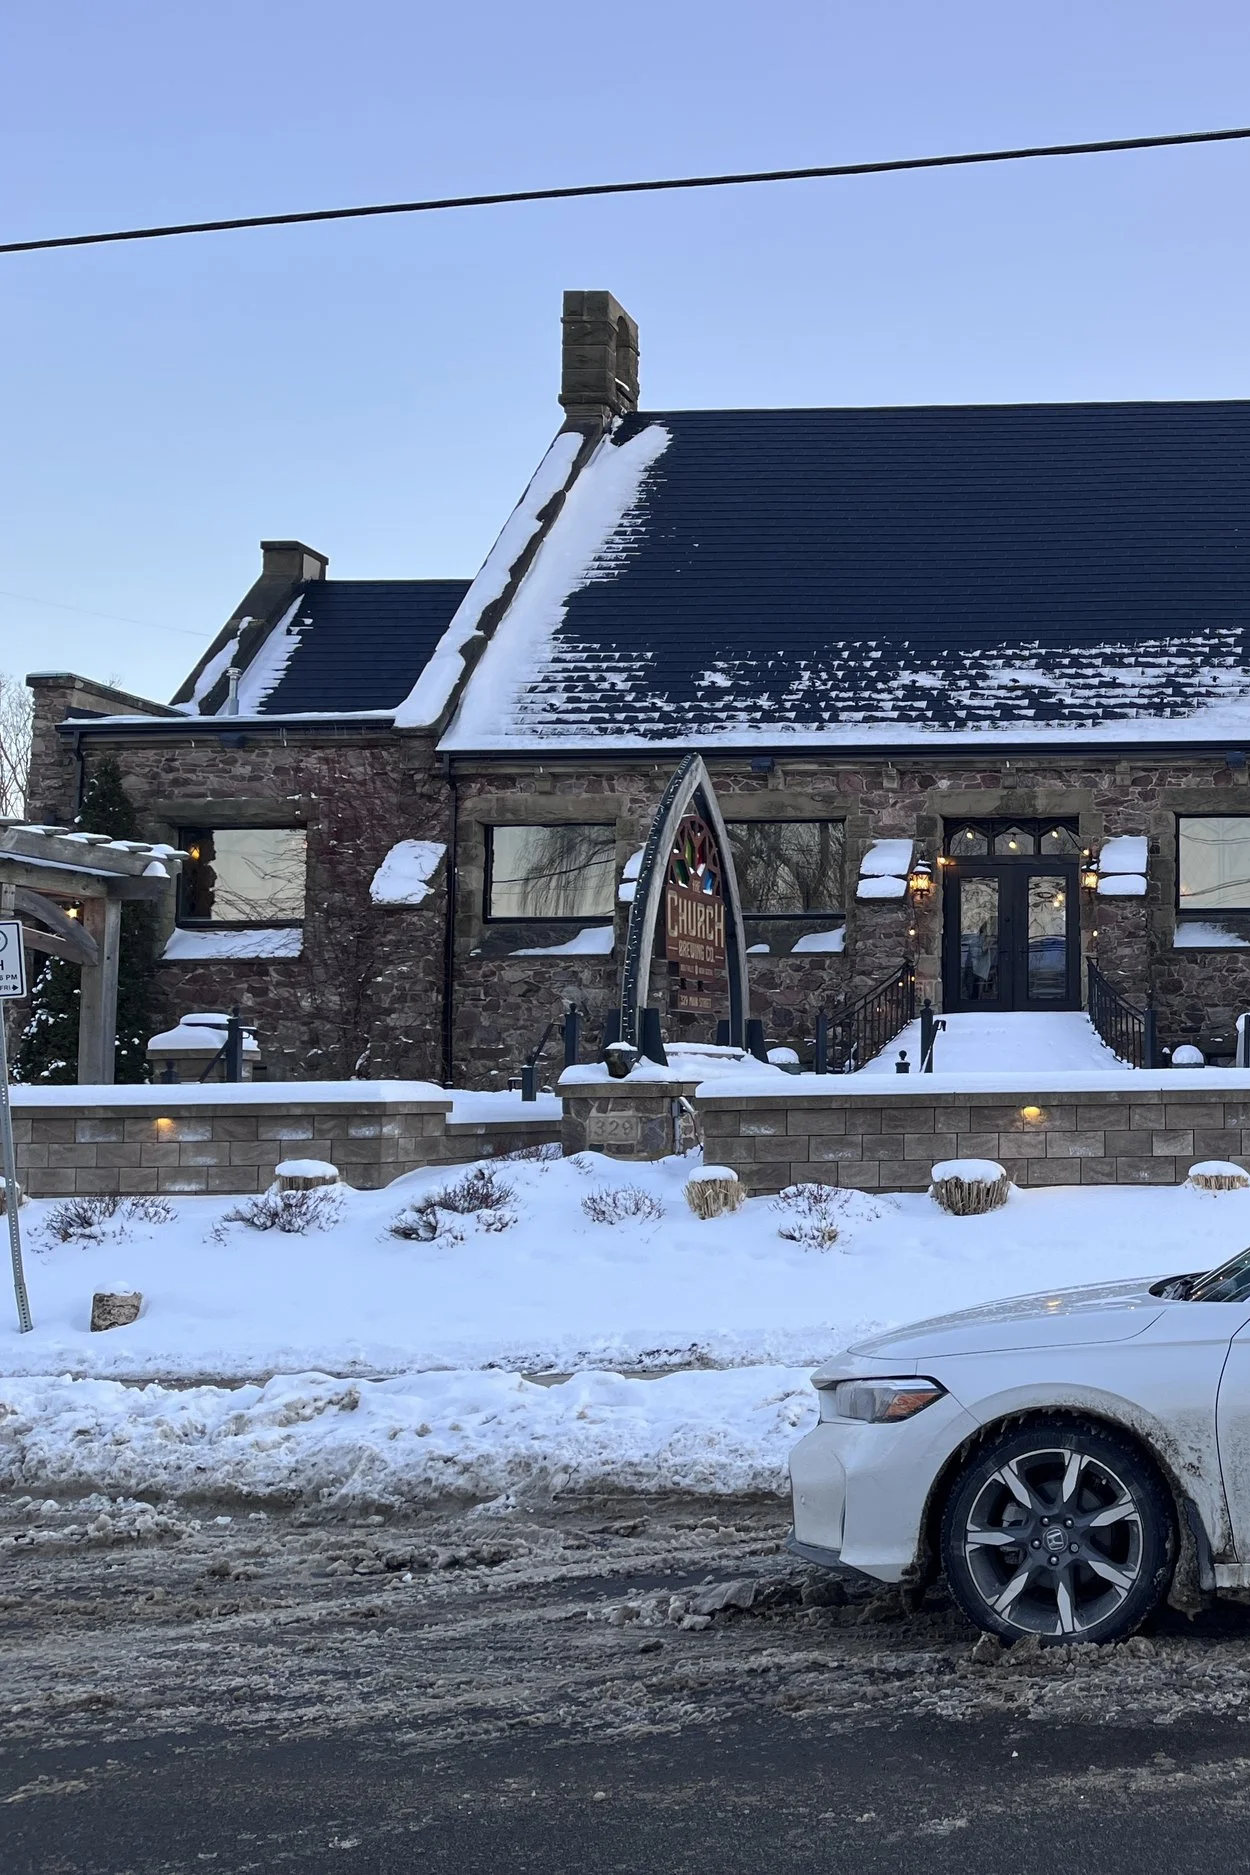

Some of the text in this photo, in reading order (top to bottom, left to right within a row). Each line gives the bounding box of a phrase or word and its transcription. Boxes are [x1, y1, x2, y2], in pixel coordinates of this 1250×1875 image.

[668, 890, 724, 948] CHURCH
[679, 940, 704, 960] BREWING
[594, 1120, 632, 1136] 329
